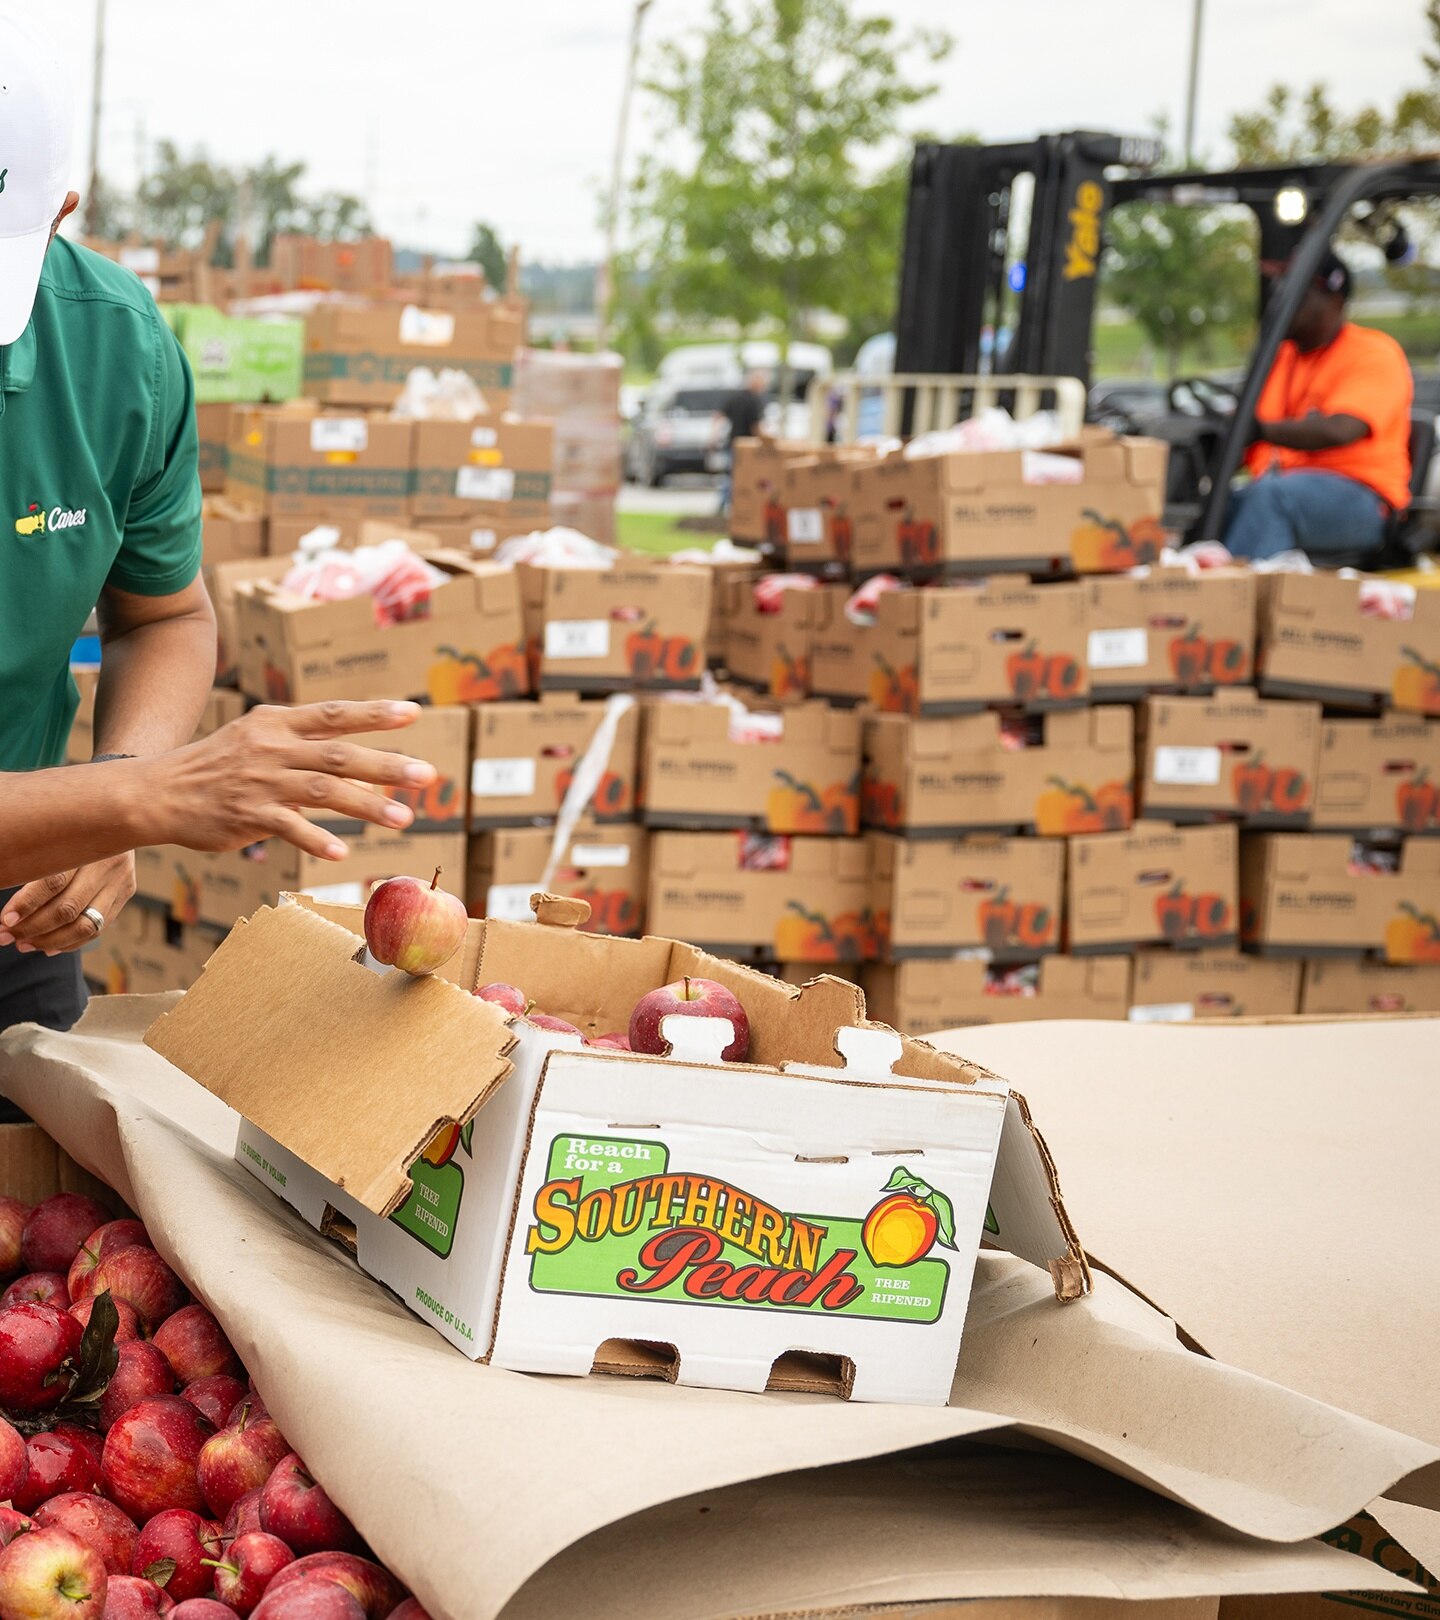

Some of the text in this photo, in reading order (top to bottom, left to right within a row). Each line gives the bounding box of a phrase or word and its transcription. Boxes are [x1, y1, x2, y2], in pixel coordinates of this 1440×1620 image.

[1063, 179, 1104, 282] Yale
[47, 506, 87, 532] Cares
[566, 1138, 652, 1161] Reach
[563, 1156, 623, 1174] for a
[419, 1183, 440, 1207] TREE
[414, 1205, 449, 1237] RIPENED
[524, 1174, 828, 1272] SOUTHERN
[616, 1228, 865, 1311] Peach
[874, 1277, 911, 1291] TREE
[416, 1286, 474, 1341] PRODUCE OF U.S.A.
[871, 1294, 932, 1308] RIPENED
[1348, 1589, 1412, 1610] proprietary
